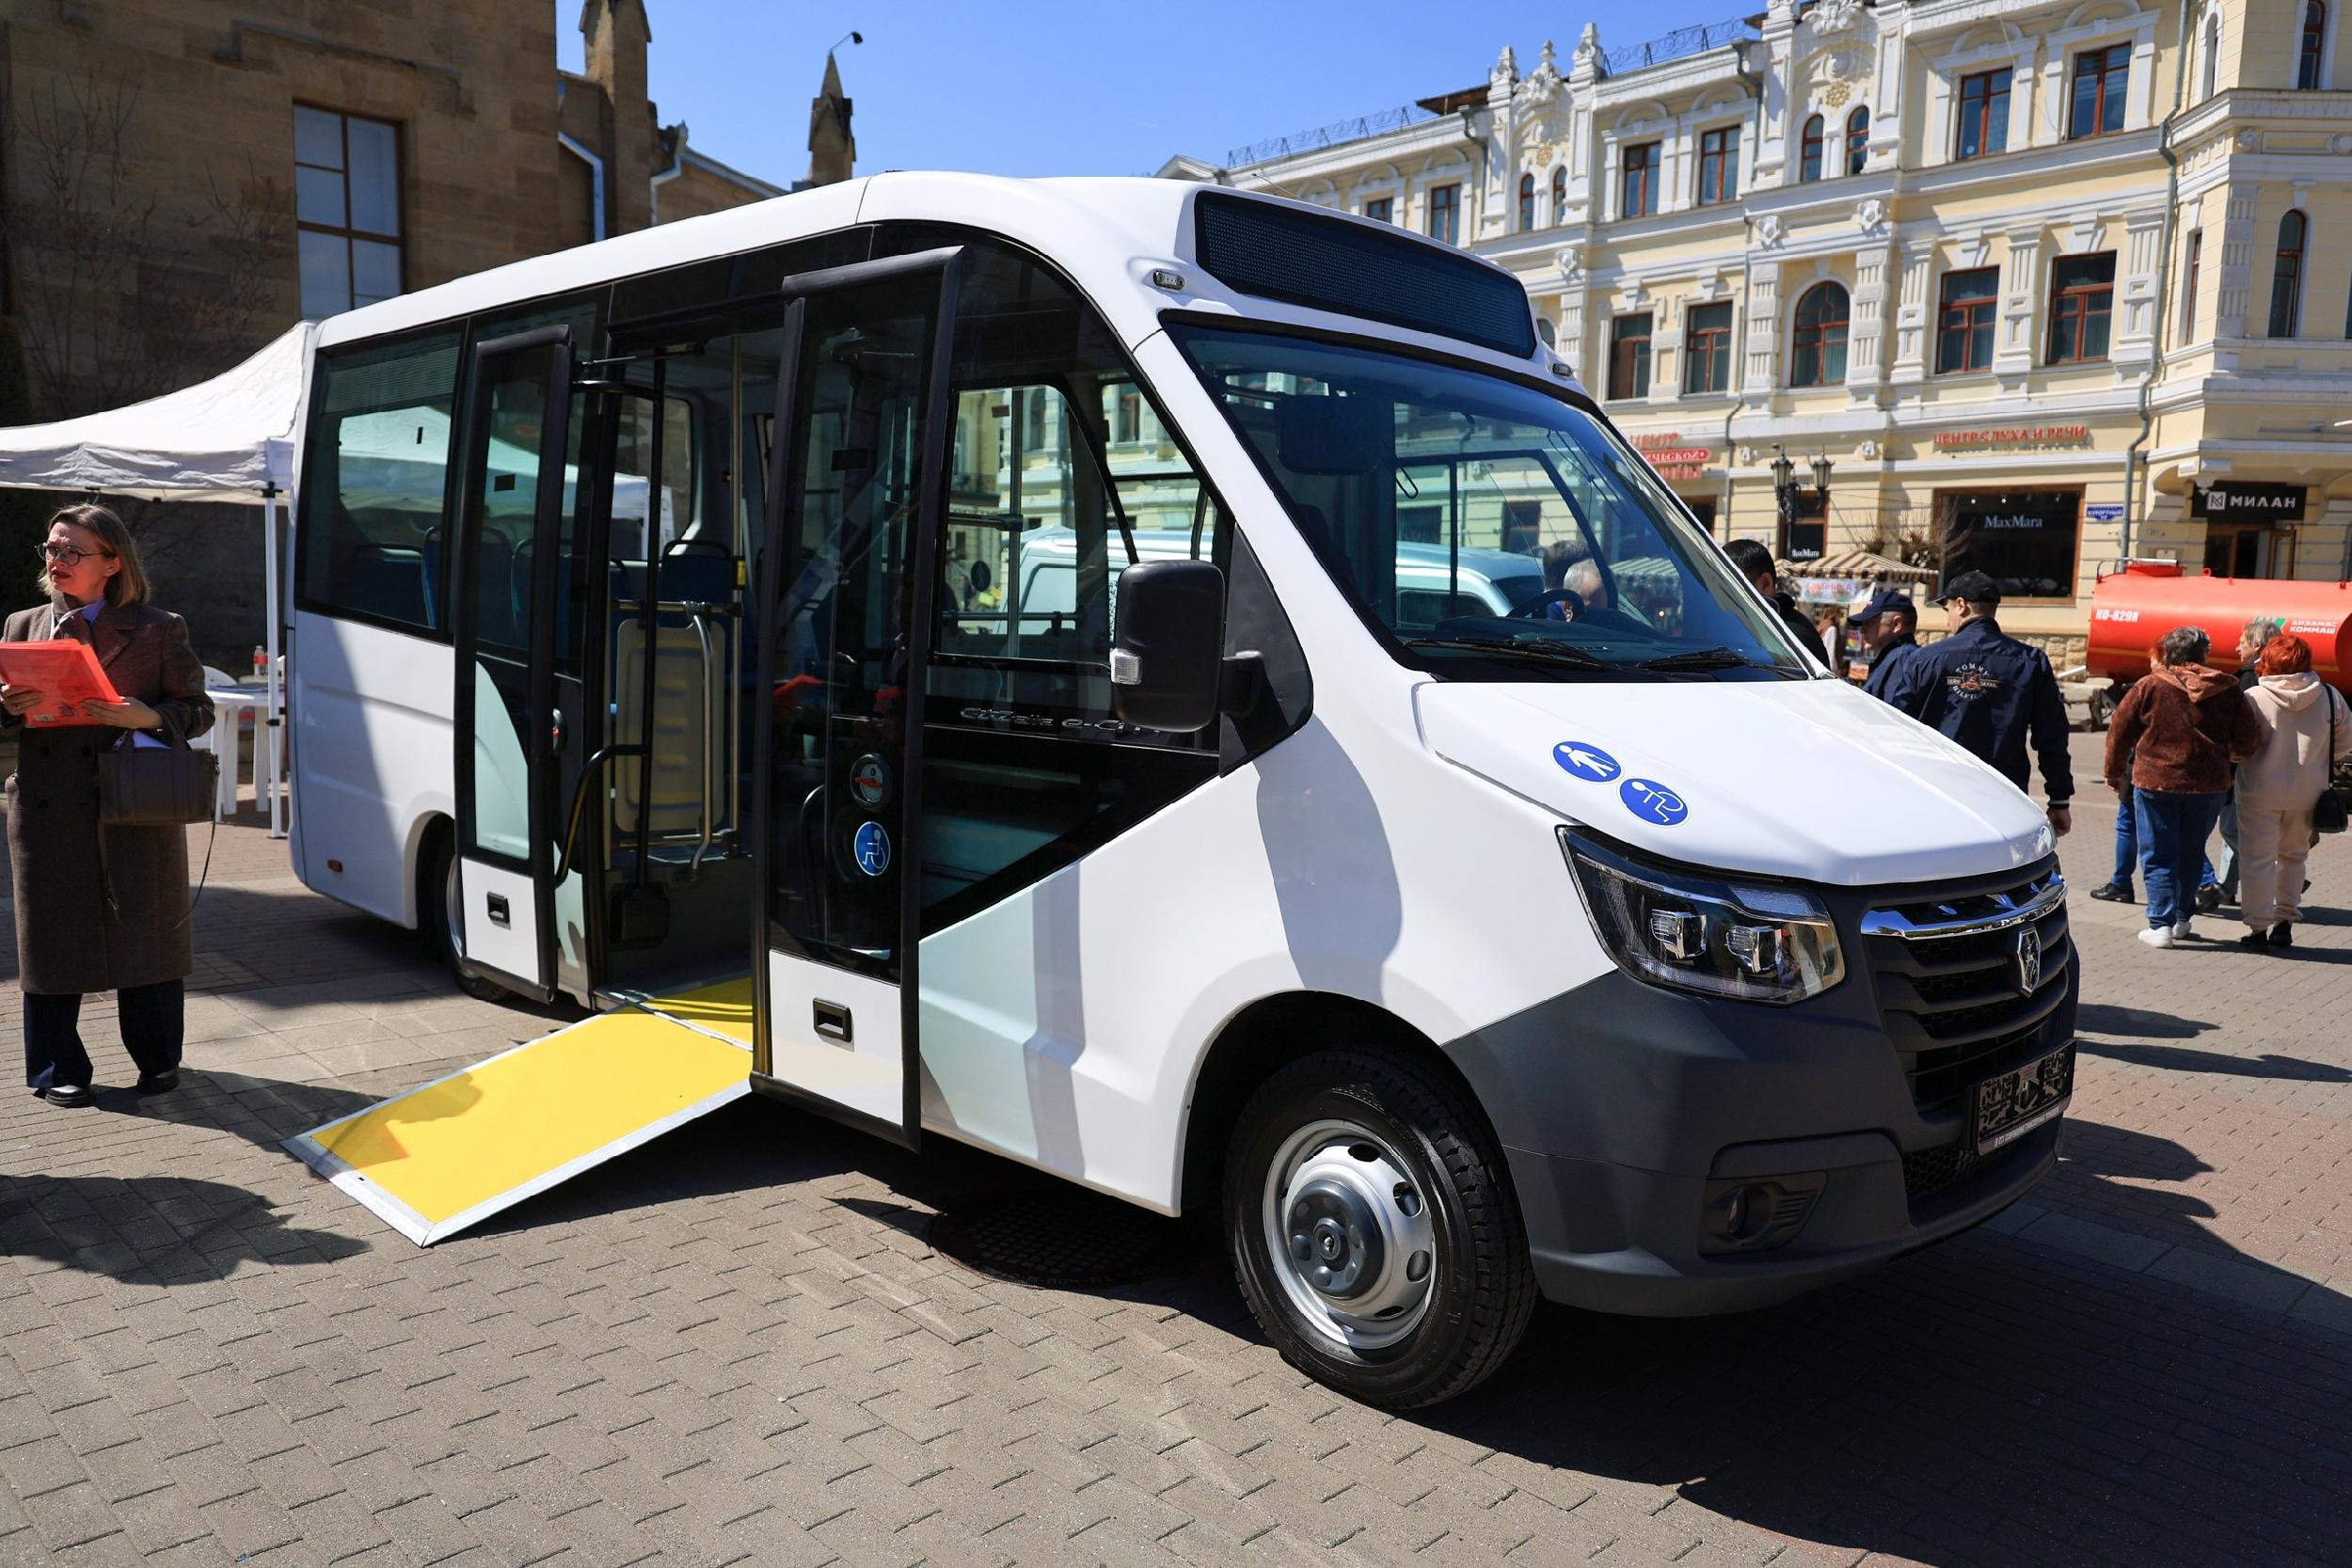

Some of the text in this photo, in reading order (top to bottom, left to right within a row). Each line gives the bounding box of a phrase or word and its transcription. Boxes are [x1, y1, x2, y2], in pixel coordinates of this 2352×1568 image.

[1933, 432, 1979, 445] ЦЕНТР
[2046, 426, 2087, 439] РЕЧИ
[2230, 495, 2296, 508] МИЛАН
[1984, 515, 2042, 528] MaxMara
[1955, 662, 1990, 677] TOMMY
